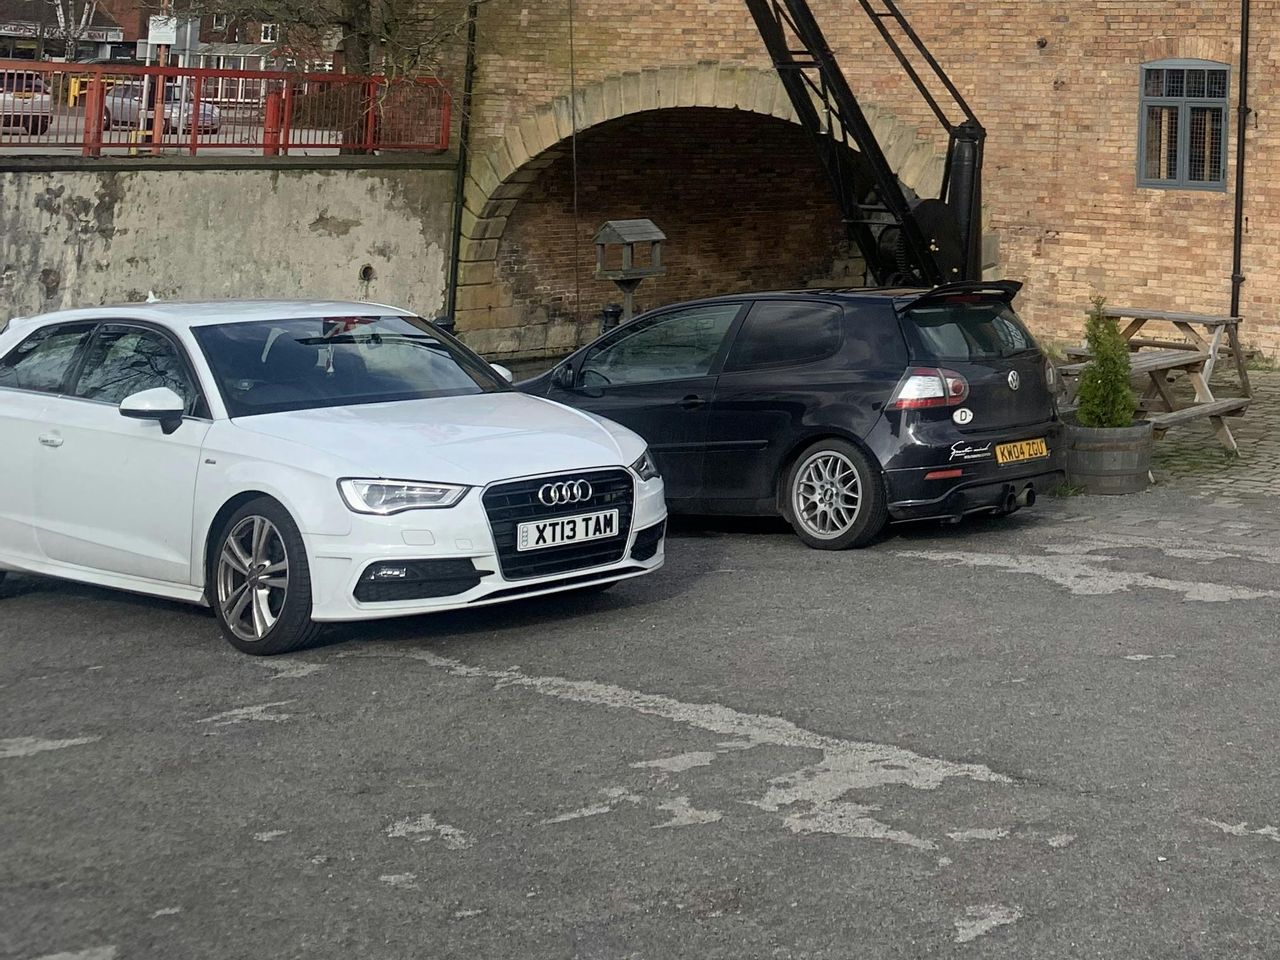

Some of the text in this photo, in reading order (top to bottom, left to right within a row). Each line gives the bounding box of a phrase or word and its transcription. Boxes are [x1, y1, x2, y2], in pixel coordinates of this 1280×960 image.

[960, 410, 968, 422] D
[1000, 445, 1025, 461] KW04
[1025, 440, 1045, 457] ZGU
[535, 513, 614, 545] XT13 TAM
